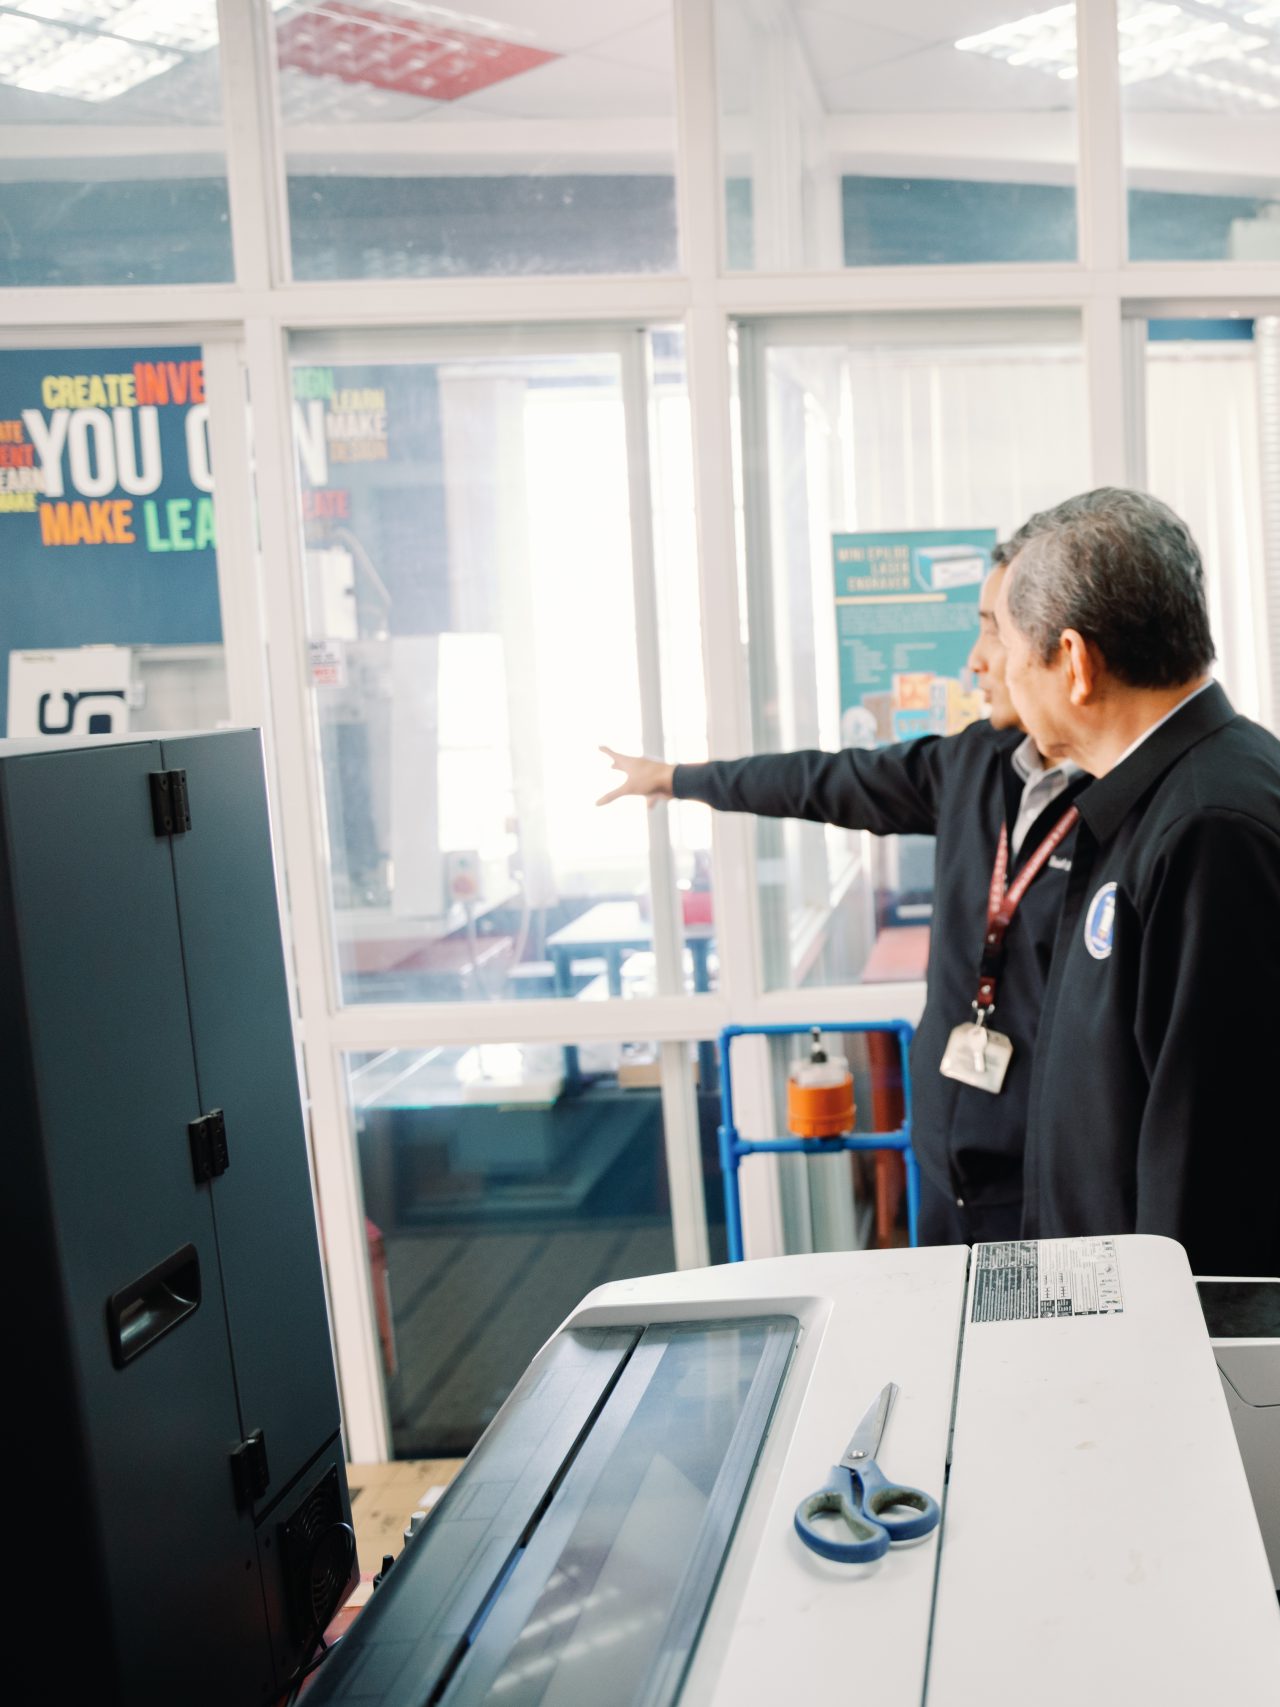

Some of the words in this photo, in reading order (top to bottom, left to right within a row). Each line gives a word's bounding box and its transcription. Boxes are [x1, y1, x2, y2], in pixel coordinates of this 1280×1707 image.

[42, 374, 137, 409] CREATE
[22, 406, 163, 498] YOU
[40, 500, 136, 547] MAKE
